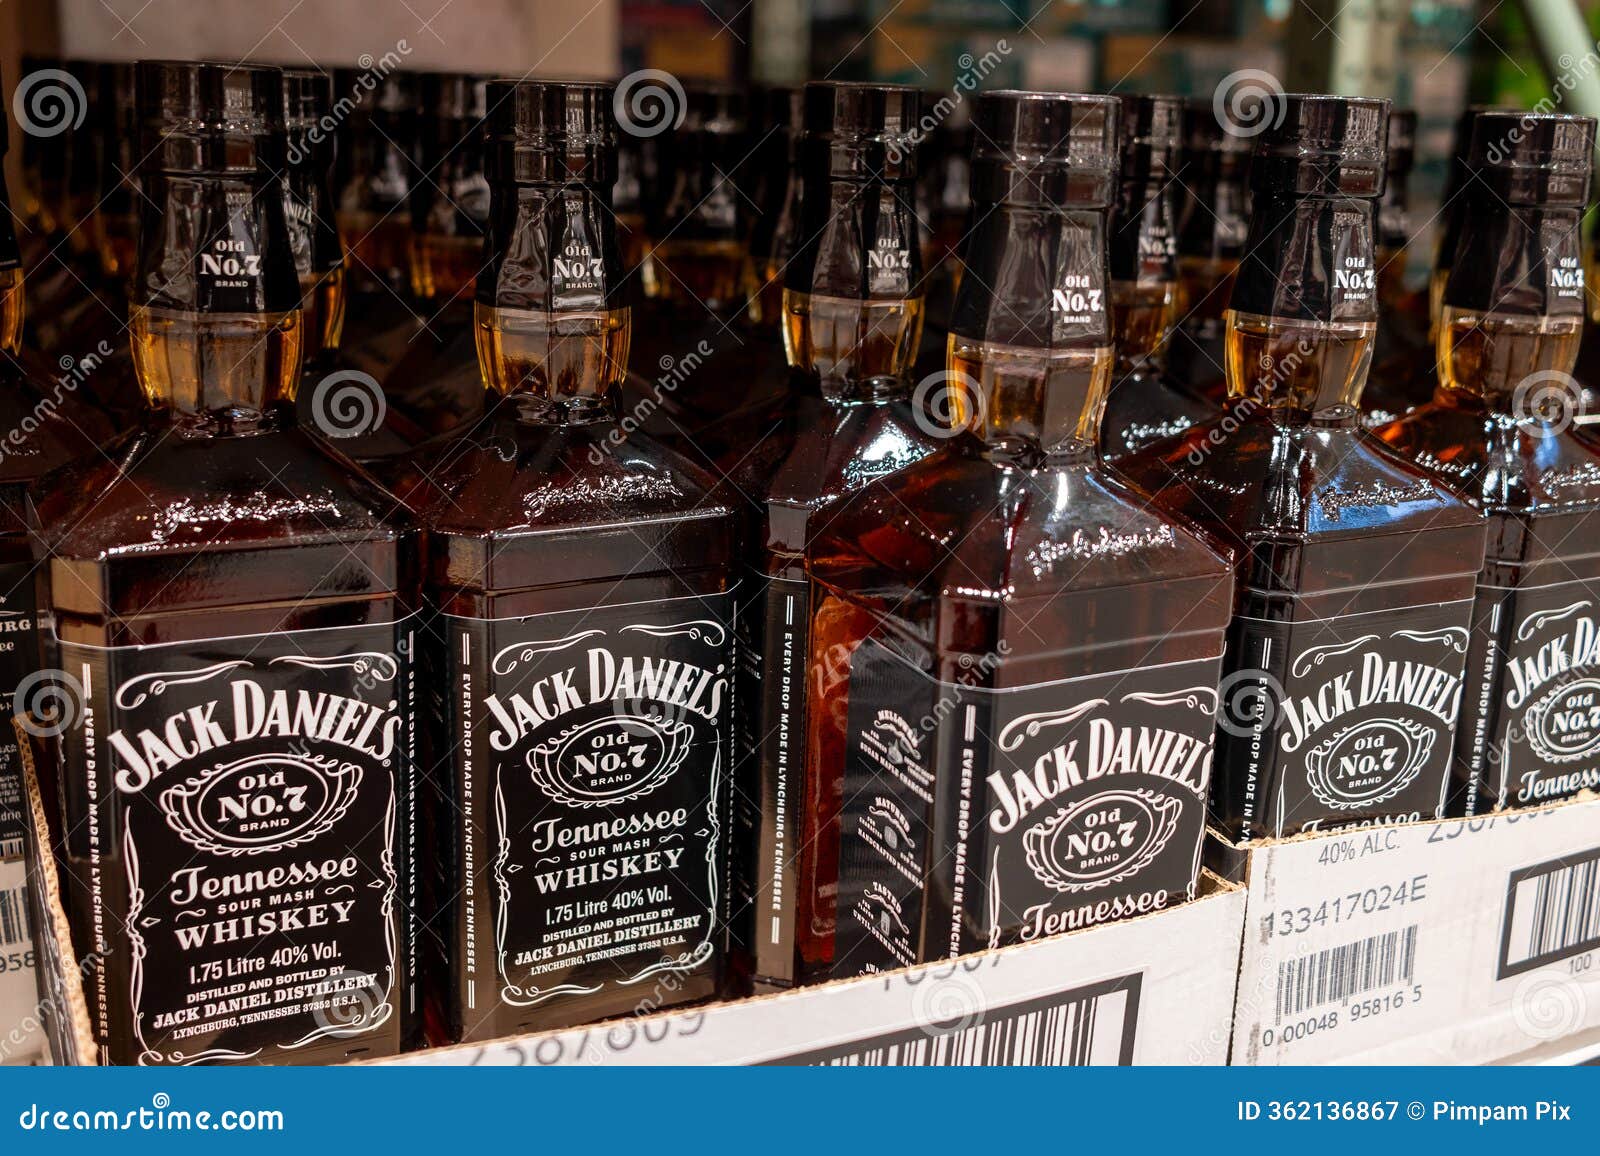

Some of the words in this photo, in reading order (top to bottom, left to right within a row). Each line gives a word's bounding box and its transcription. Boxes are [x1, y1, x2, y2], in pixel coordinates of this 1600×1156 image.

[215, 240, 245, 252] Old
[565, 246, 589, 256] Old
[878, 238, 899, 248] Old
[1065, 275, 1090, 288] Old
[1345, 257, 1365, 268] Old
[215, 280, 248, 288] BRAND
[783, 632, 792, 674] EVERY
[1483, 639, 1497, 681] EVERY
[1506, 633, 1569, 710] JACK
[462, 673, 472, 719] EVERY
[483, 666, 586, 751] JACK
[587, 647, 728, 720] DANIEL'S
[782, 676, 791, 710] DROP
[1255, 677, 1268, 721] EVERY
[1279, 670, 1357, 753] JACK
[1480, 682, 1491, 716] DROP
[1566, 692, 1594, 709] Old
[84, 708, 95, 757] EVERY
[107, 700, 230, 794] JACK
[230, 679, 402, 763] DANIEL'S
[463, 721, 472, 756] DROP
[591, 732, 629, 749] Old
[780, 713, 789, 749] MADE
[1250, 724, 1263, 759] DROP
[1354, 734, 1385, 750] Old
[1473, 718, 1485, 753] MADE
[779, 751, 788, 764] IN
[961, 748, 974, 798] EVERY
[1471, 755, 1481, 769] IN
[86, 760, 97, 800] DROP
[238, 771, 286, 790] Old
[464, 760, 472, 798] MADE
[590, 773, 632, 787] BRAND
[985, 739, 1084, 834] JACK
[1245, 763, 1258, 801] MADE
[1348, 776, 1382, 789] BRAND
[464, 801, 472, 815] IN
[776, 767, 787, 839] LYNCHBURG
[958, 800, 970, 840] DROP
[1084, 807, 1121, 828] Old
[1243, 803, 1254, 817] IN
[89, 804, 99, 846] MADE
[240, 817, 290, 833] BRAND
[532, 808, 687, 853] Tennessee
[90, 849, 100, 865] IN
[465, 819, 474, 896] LYNCHBURG
[570, 845, 606, 862] SOUR
[612, 838, 651, 853] MASH
[955, 843, 967, 884] MADE
[1080, 852, 1120, 870] BRAND
[1318, 839, 1356, 867] 40%
[1360, 829, 1401, 858] ALC.
[170, 857, 358, 905] Tennessee
[534, 847, 685, 895] WHISKEY
[92, 867, 103, 952] LYNCHBURG
[218, 896, 262, 914] SOUR
[269, 889, 315, 906] MASH
[546, 904, 573, 926] 1.75
[576, 899, 608, 919] Litre
[612, 889, 644, 910] 40%
[647, 885, 672, 902] Vol.
[953, 886, 963, 902] IN
[1264, 874, 1428, 938] 133417024E
[175, 900, 356, 951] WHISKEY
[543, 925, 591, 943] DISTILLED
[593, 920, 614, 932] AND
[616, 911, 659, 928] BOTTLED
[661, 907, 675, 918] BY
[1020, 889, 1169, 941] Tennessee
[466, 900, 475, 973] TENNESSEE
[514, 948, 553, 966] JACK
[557, 934, 612, 956] DANIEL
[614, 915, 701, 942] DISTILLERY
[585, 943, 637, 962] TENNESSEE
[190, 960, 223, 985] 1.75
[227, 956, 265, 978] Litre
[270, 946, 308, 968] 40%
[312, 941, 342, 960] Vol.
[97, 956, 108, 1037] TENNESSEE
[153, 1010, 200, 1030] JACK
[204, 994, 271, 1018] DANIEL
[274, 972, 377, 1003] DISTILLERY
[187, 984, 246, 1004] DISTILLED
[249, 979, 273, 992] AND
[276, 970, 327, 987] BOTTLED
[330, 966, 345, 977] BY
[240, 1004, 301, 1025] TENNESSEE
[1262, 1029, 1274, 1047] 0
[1283, 1012, 1339, 1043] 00048
[1350, 991, 1404, 1022] 95816
[1412, 985, 1423, 1003] 5
